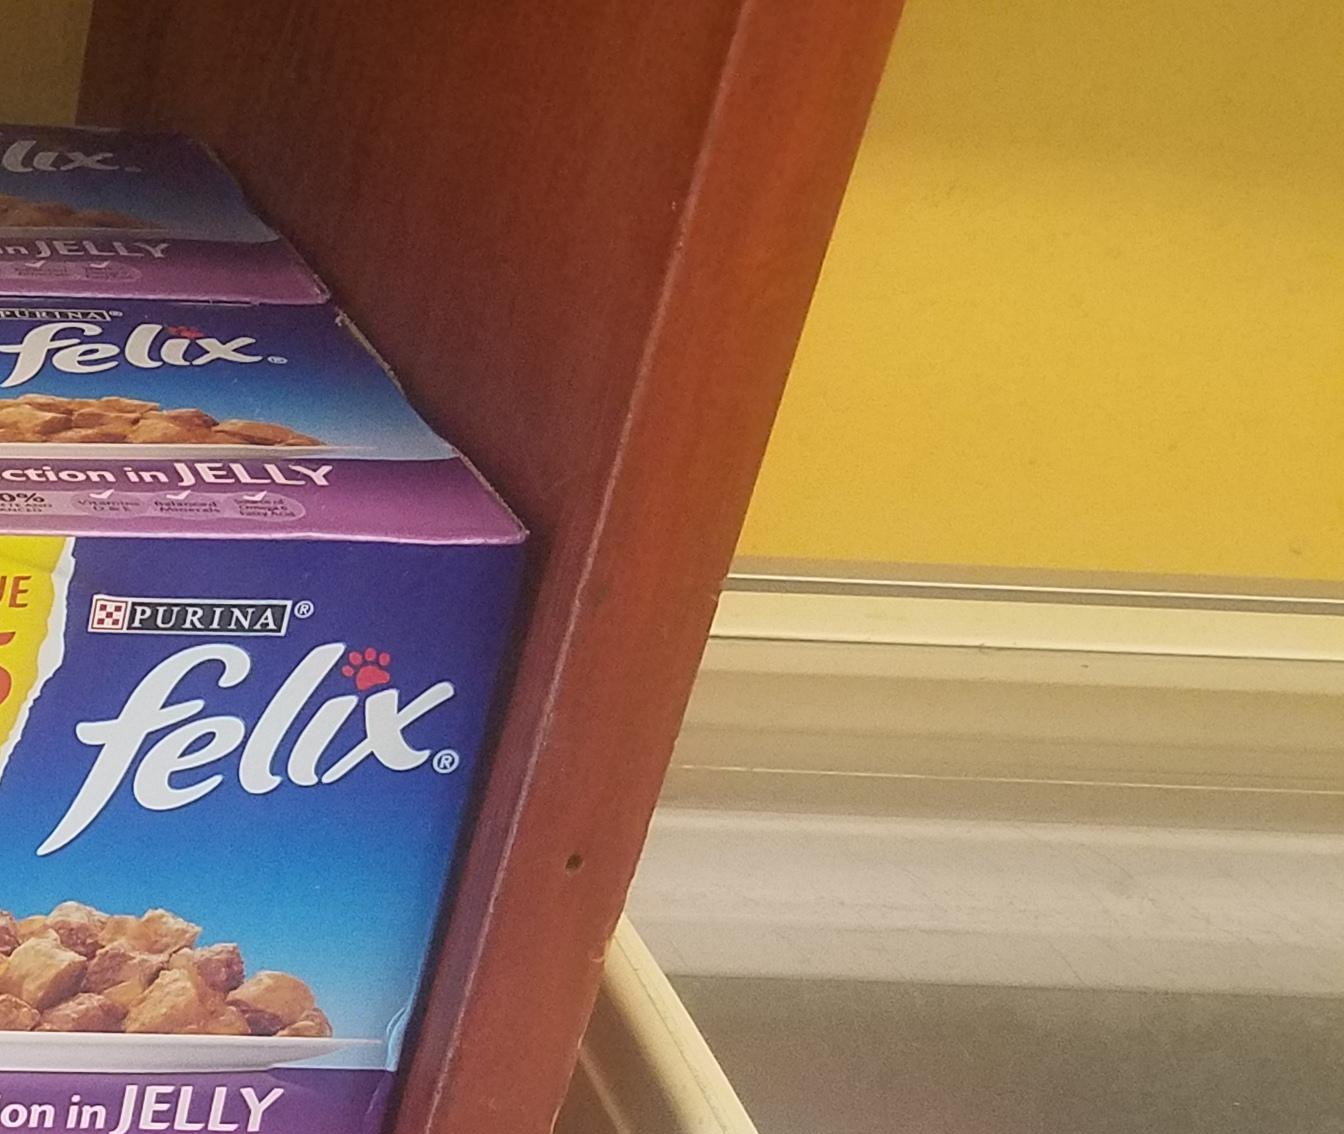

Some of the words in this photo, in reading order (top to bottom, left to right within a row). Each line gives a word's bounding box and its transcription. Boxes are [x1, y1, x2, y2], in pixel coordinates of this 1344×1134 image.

[34, 239, 170, 259] JELLY
[127, 465, 170, 485] in
[174, 463, 335, 487] JELLY
[130, 604, 279, 632] PURINA
[37, 641, 455, 856] felix
[66, 1095, 107, 1129] in
